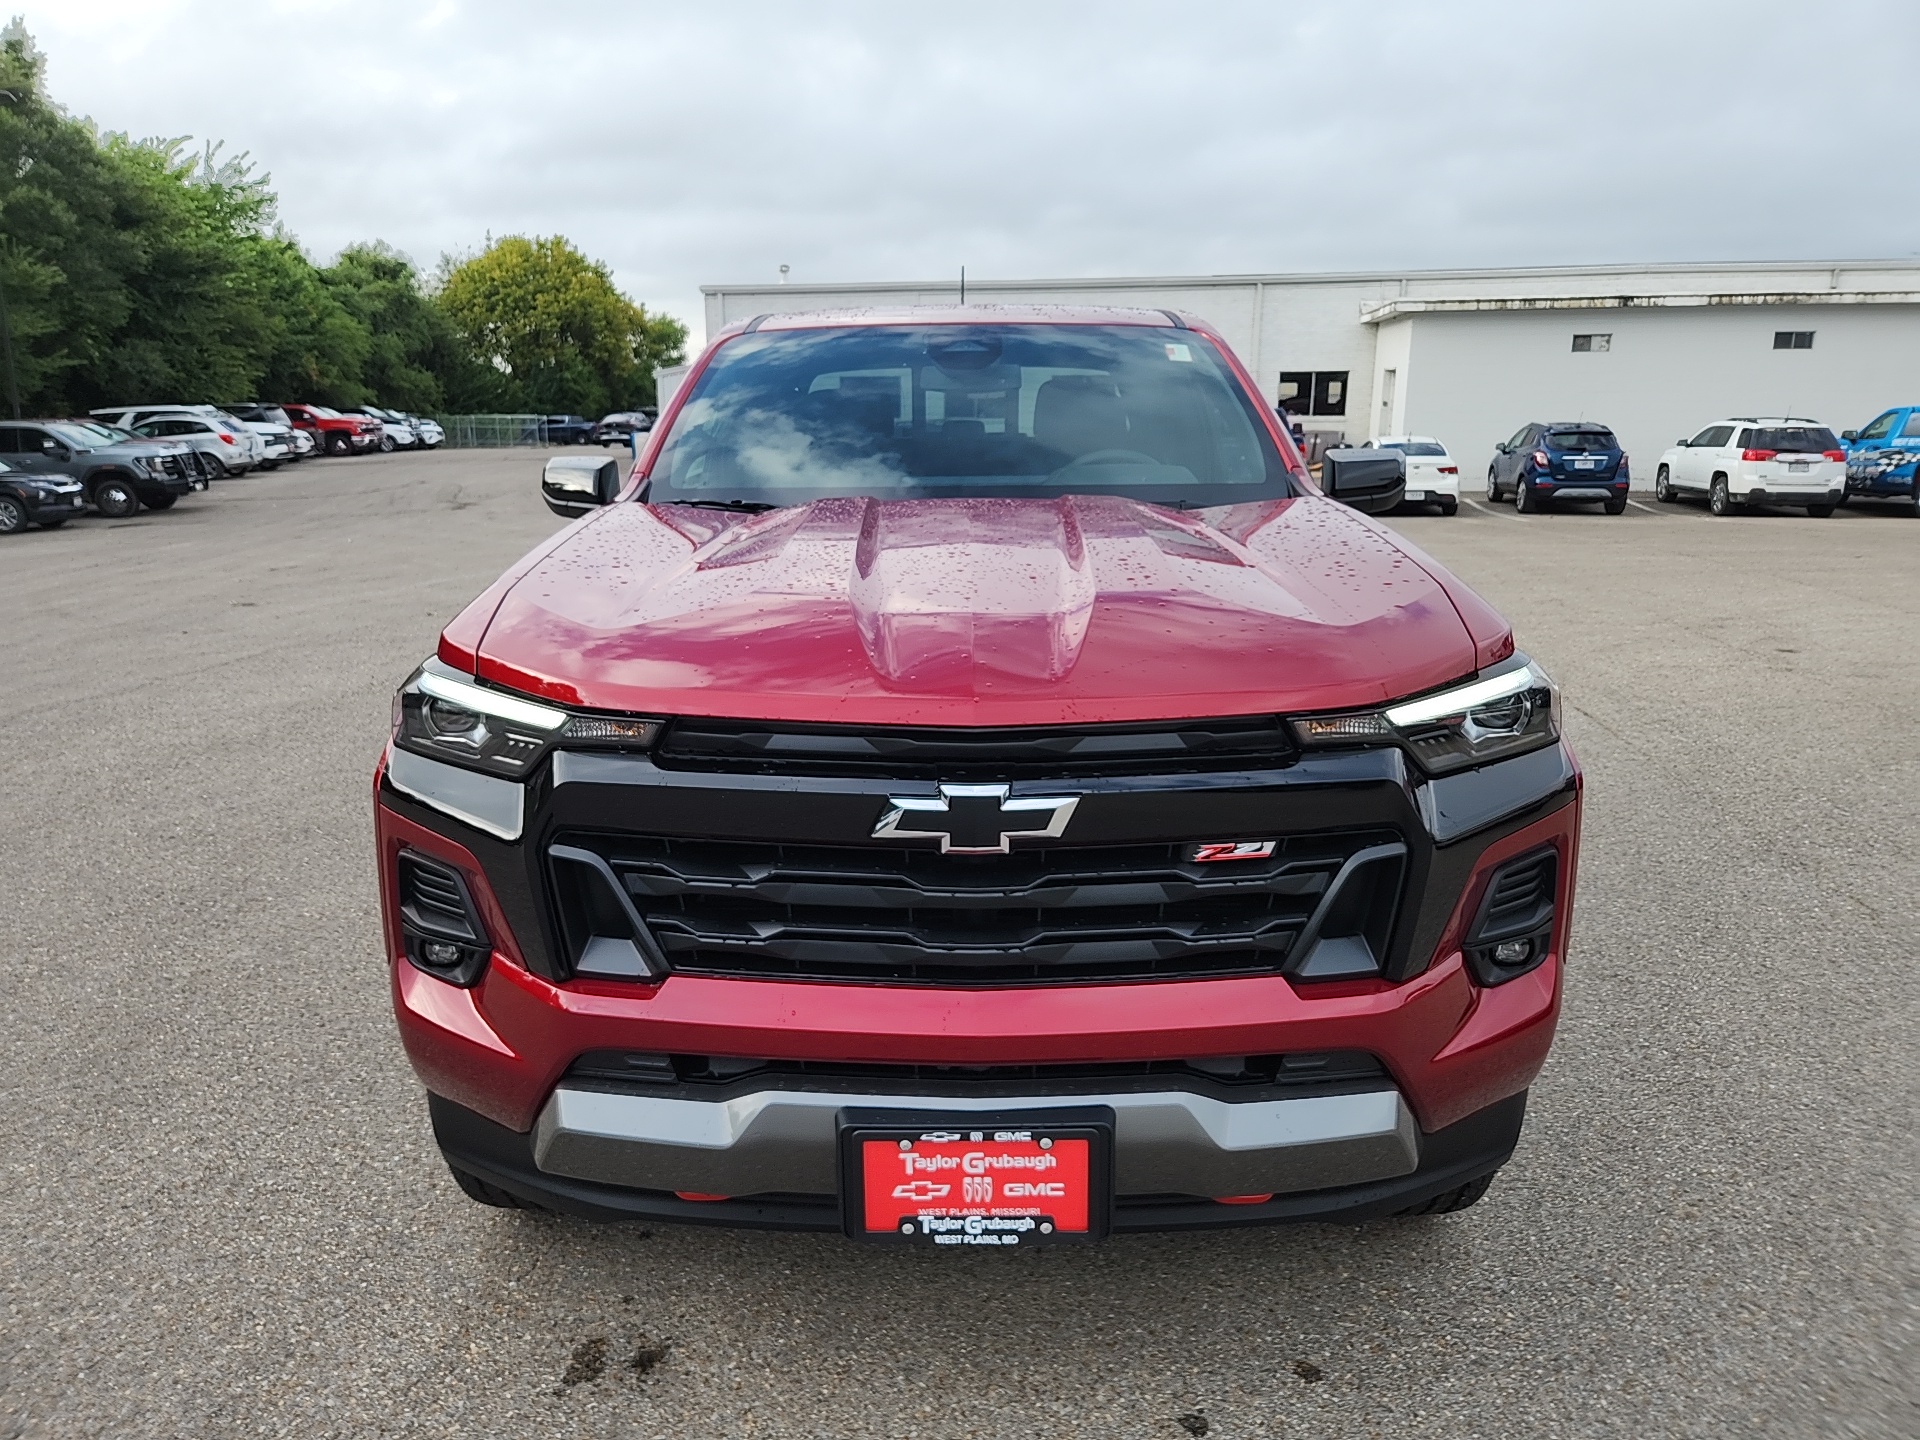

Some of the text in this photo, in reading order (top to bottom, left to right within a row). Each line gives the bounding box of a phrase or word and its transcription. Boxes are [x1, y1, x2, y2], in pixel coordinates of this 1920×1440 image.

[1192, 841, 1276, 862] Z71
[994, 1131, 1032, 1142] GMC
[898, 1152, 1057, 1175] Taylor Grubaugh
[1003, 1182, 1065, 1197] GMC
[917, 1208, 947, 1216] WEST
[991, 1207, 1041, 1216] MISSOURI
[917, 1215, 1036, 1234] Taylor Grubaugh
[934, 1235, 963, 1244] WEST
[1001, 1235, 1019, 1244] MO
